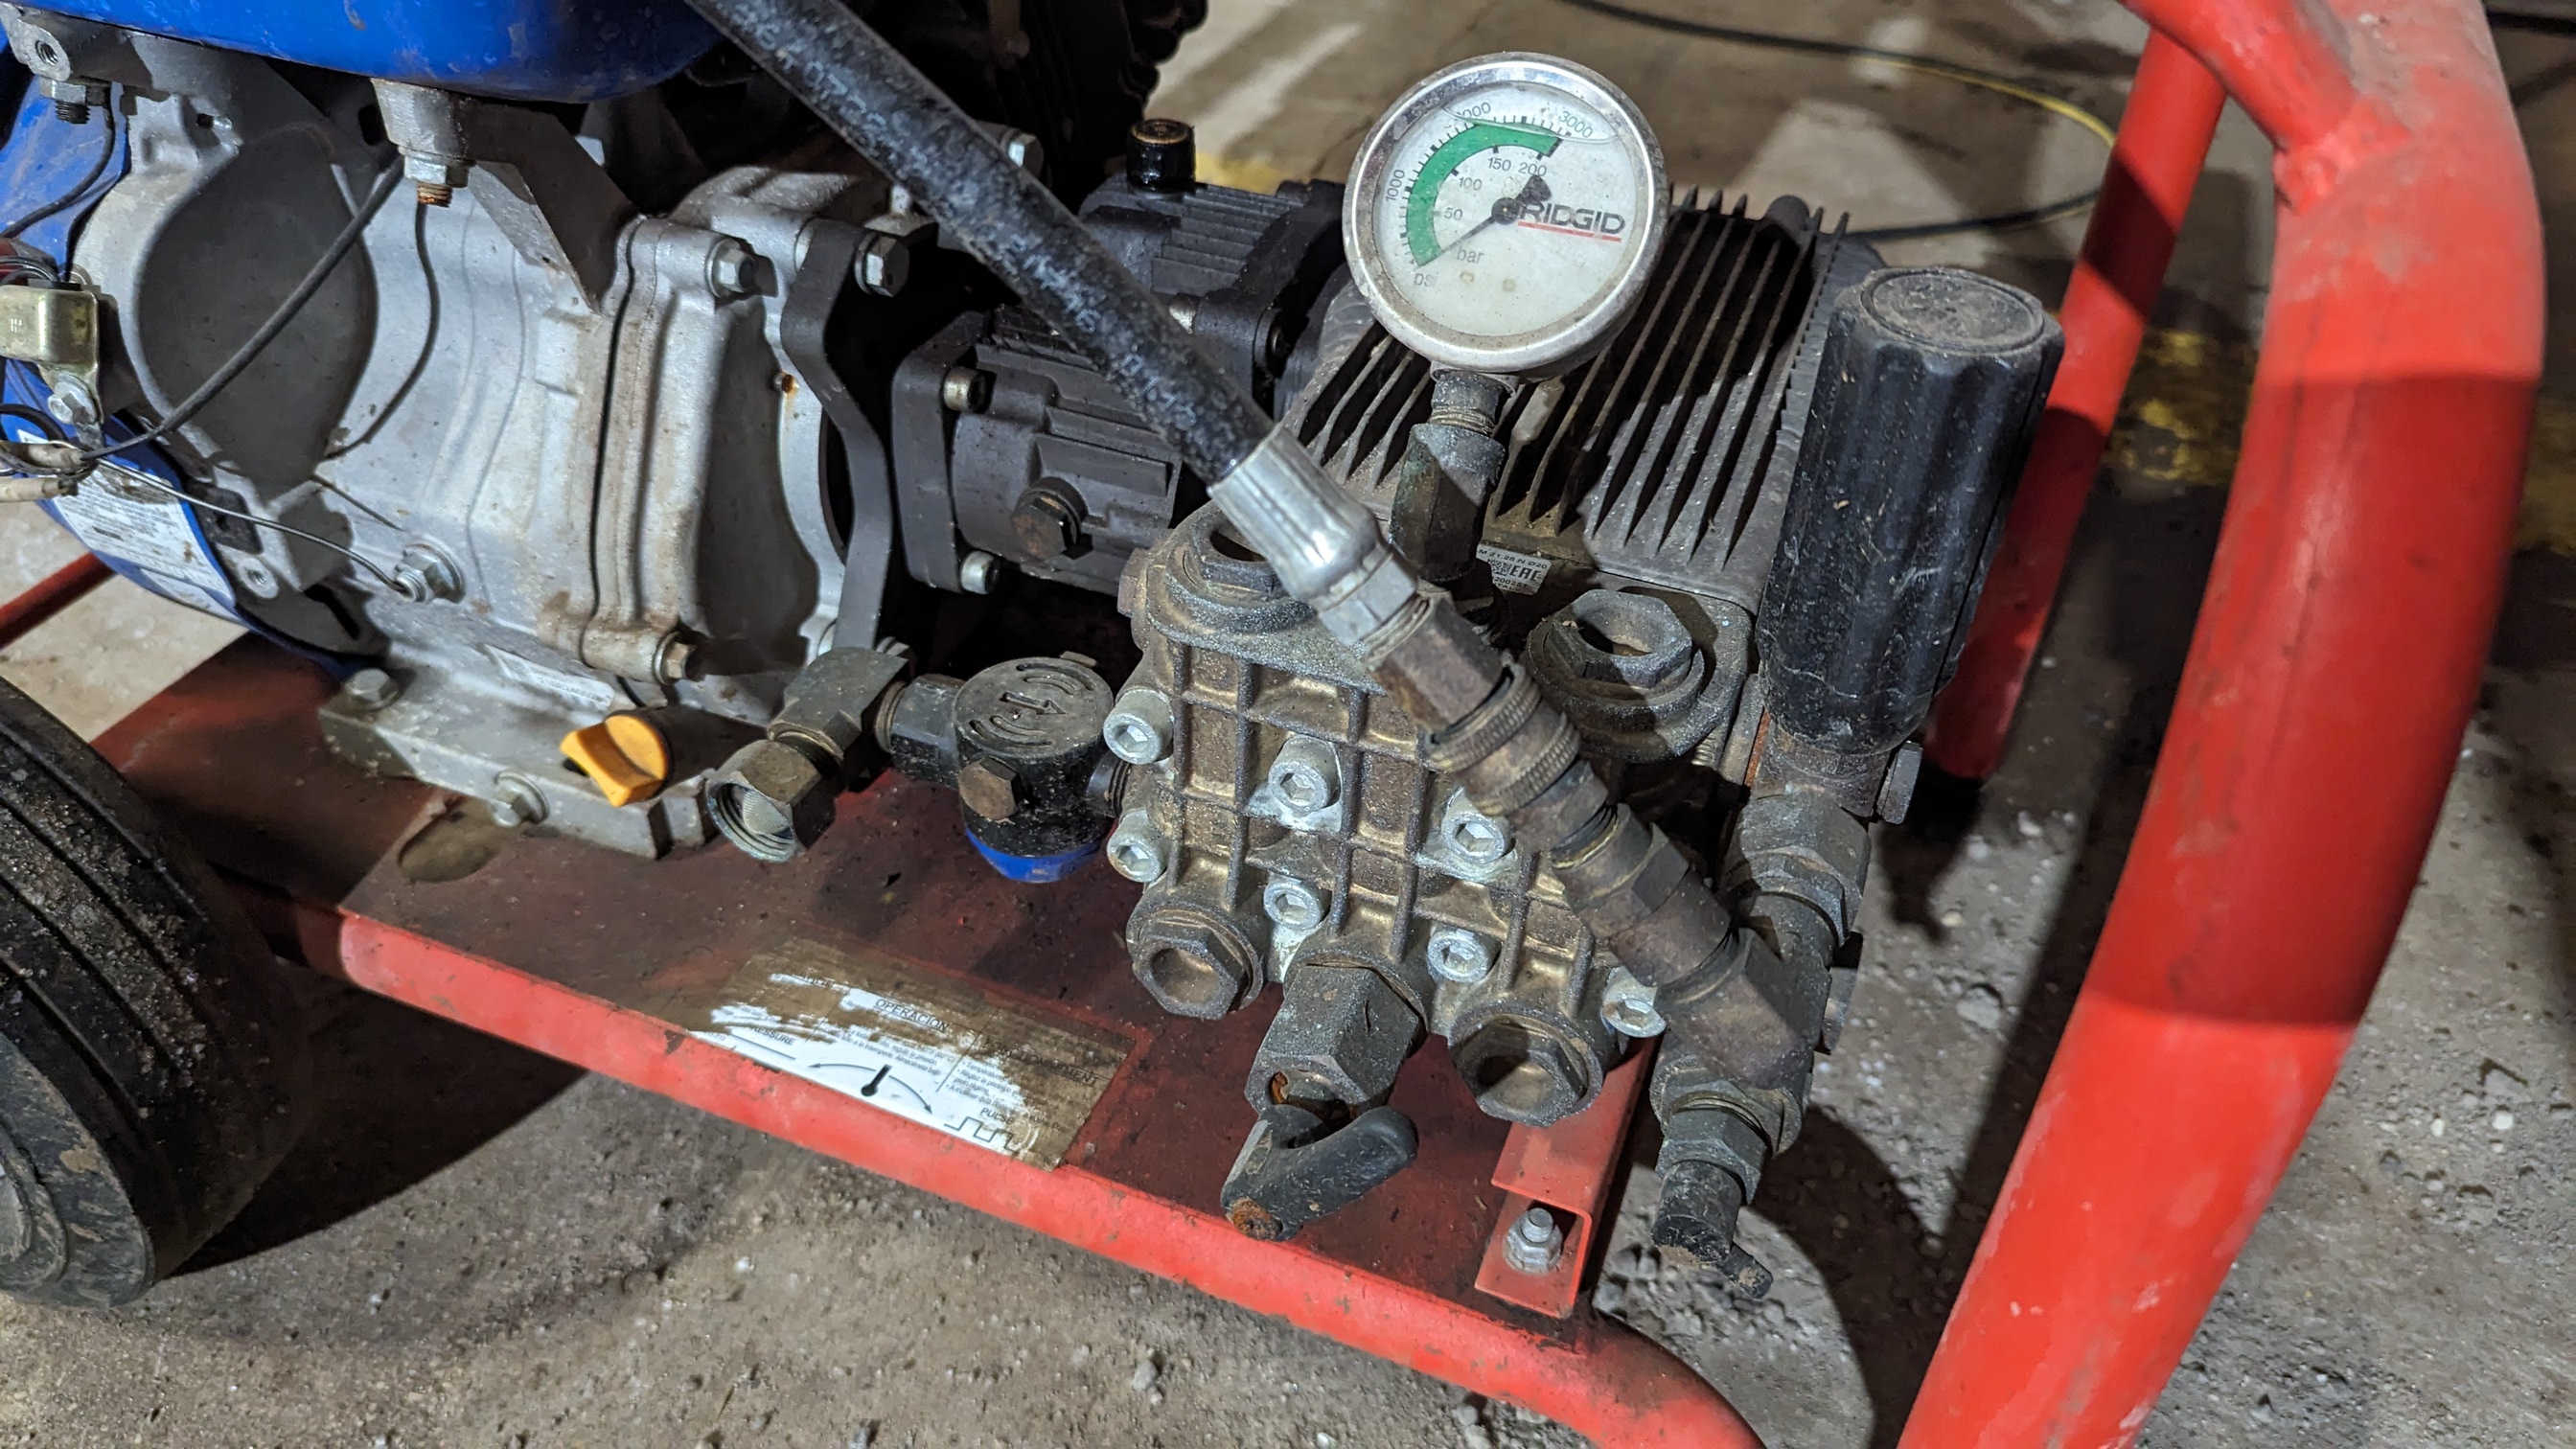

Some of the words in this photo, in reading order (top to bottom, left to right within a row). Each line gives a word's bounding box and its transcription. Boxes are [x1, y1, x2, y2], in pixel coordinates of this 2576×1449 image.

[1558, 111, 1593, 138] 3000
[1488, 157, 1511, 172] 150
[1518, 162, 1547, 176] 200
[1385, 169, 1405, 201] 1000
[1460, 176, 1483, 191] 100
[1444, 207, 1463, 220] 50
[1519, 200, 1626, 235] RIDGID
[1457, 244, 1484, 264] bar
[1414, 273, 1436, 287] ps
[749, 1024, 795, 1046] RESSURE
